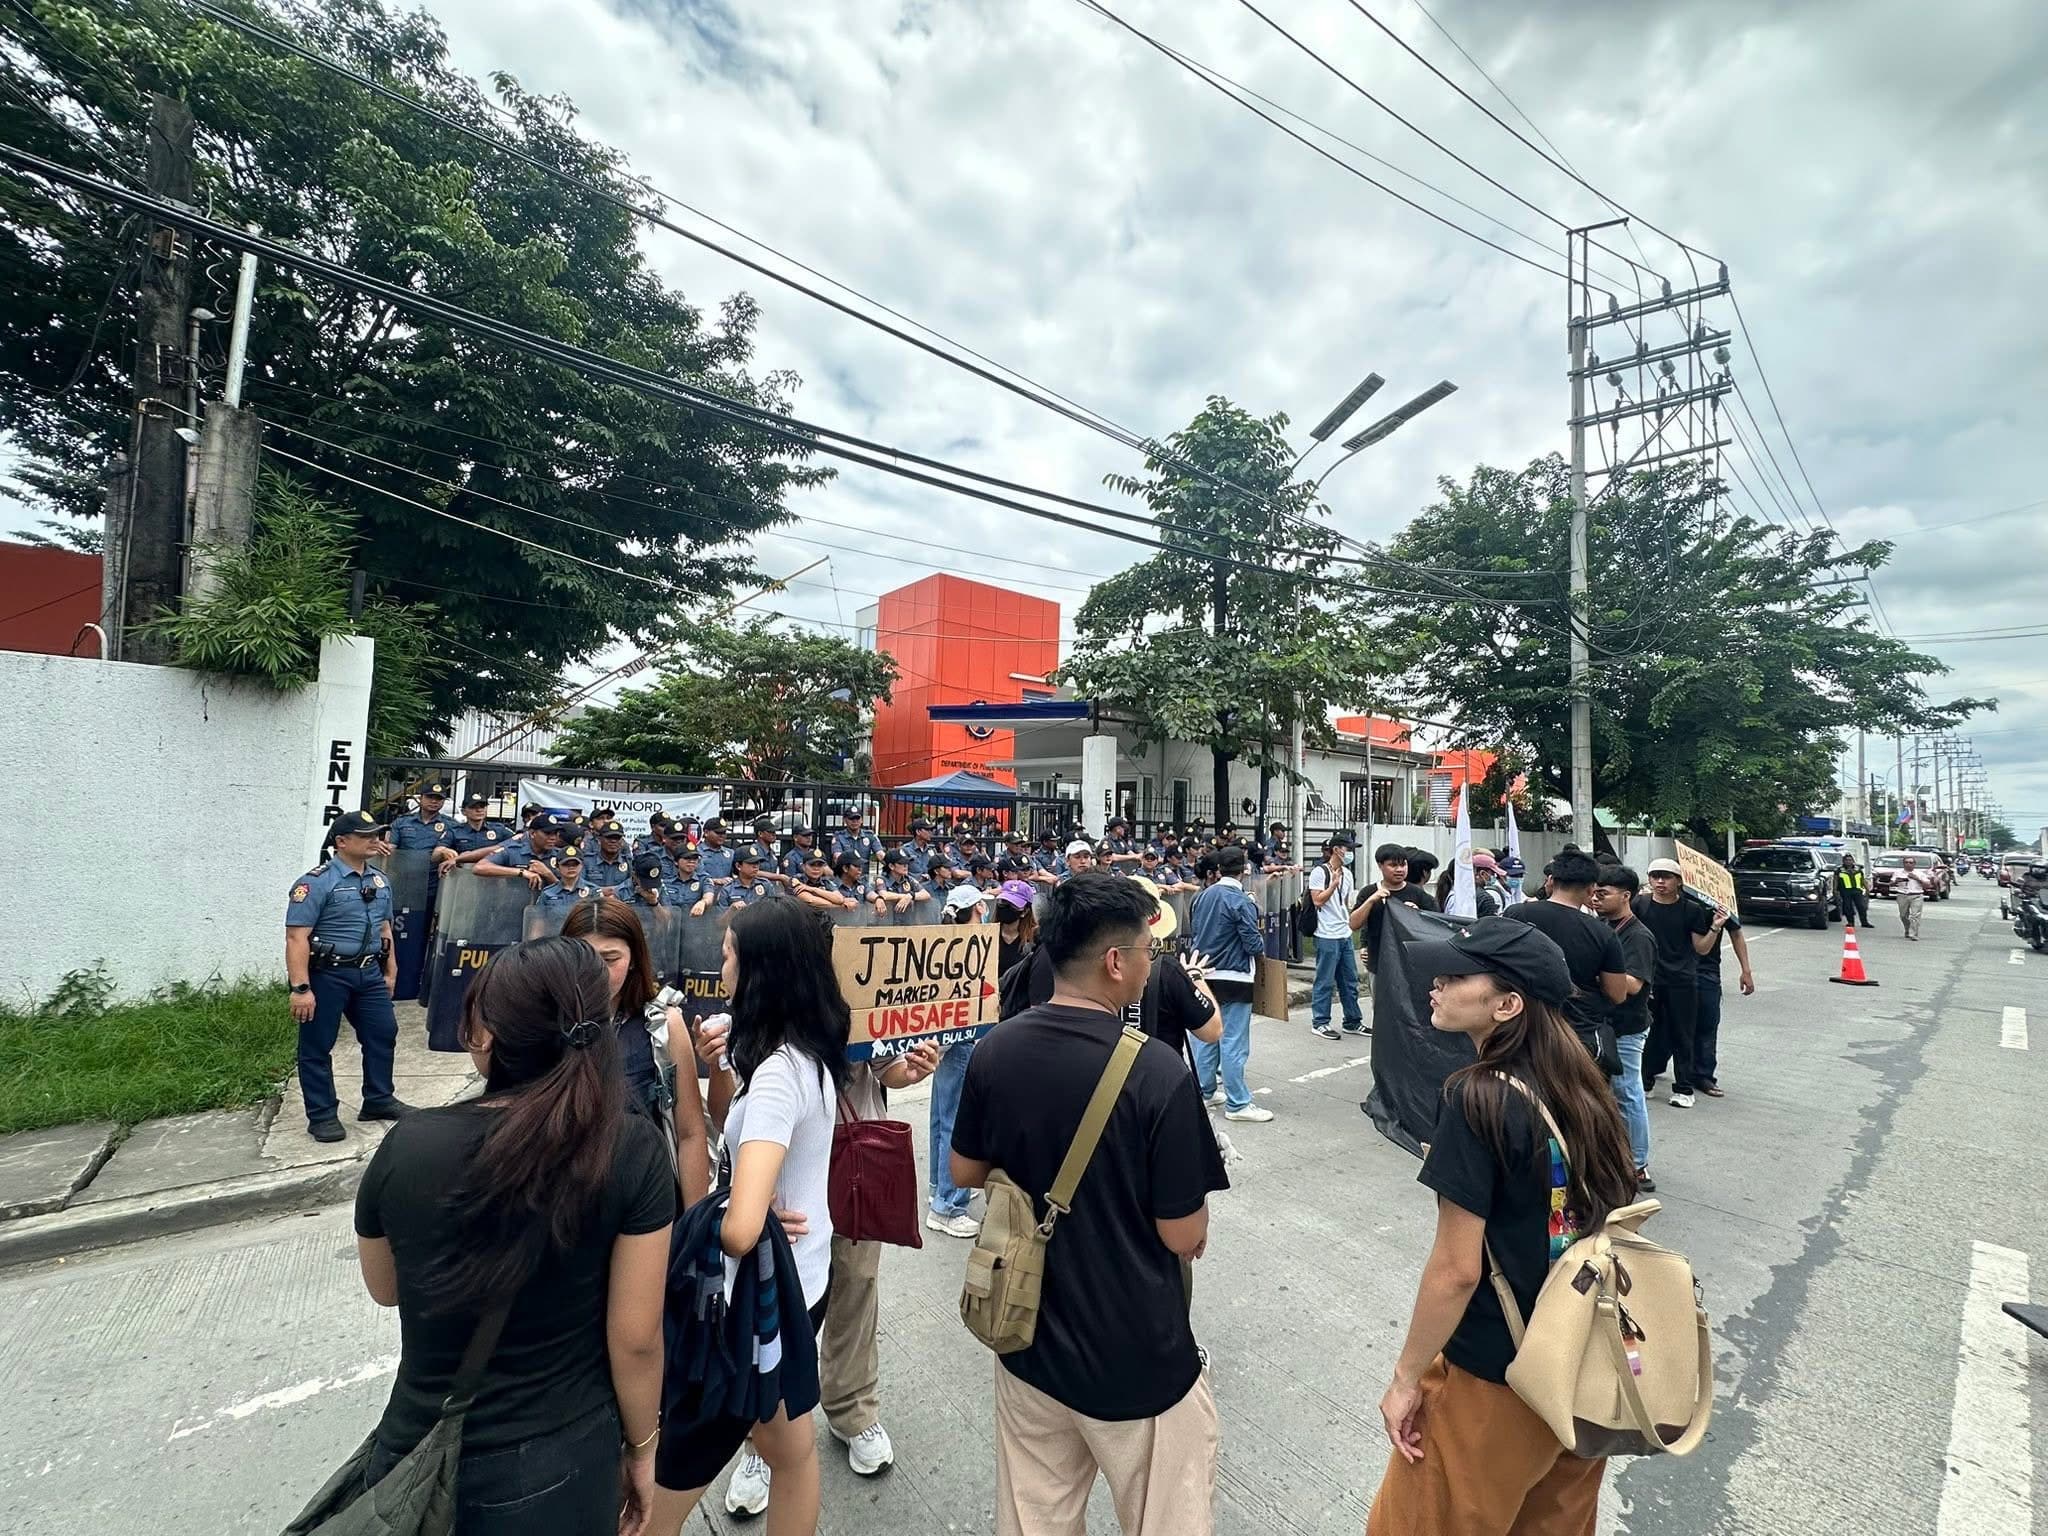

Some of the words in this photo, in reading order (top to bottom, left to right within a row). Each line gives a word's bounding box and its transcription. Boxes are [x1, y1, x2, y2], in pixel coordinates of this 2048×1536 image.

[855, 934, 993, 986] JINGGOY
[684, 978, 729, 998] PULIS
[875, 983, 940, 1008] MARKED
[949, 980, 971, 999] AS
[868, 1001, 970, 1039] UNSAFE
[942, 1027, 977, 1045] BULSU
